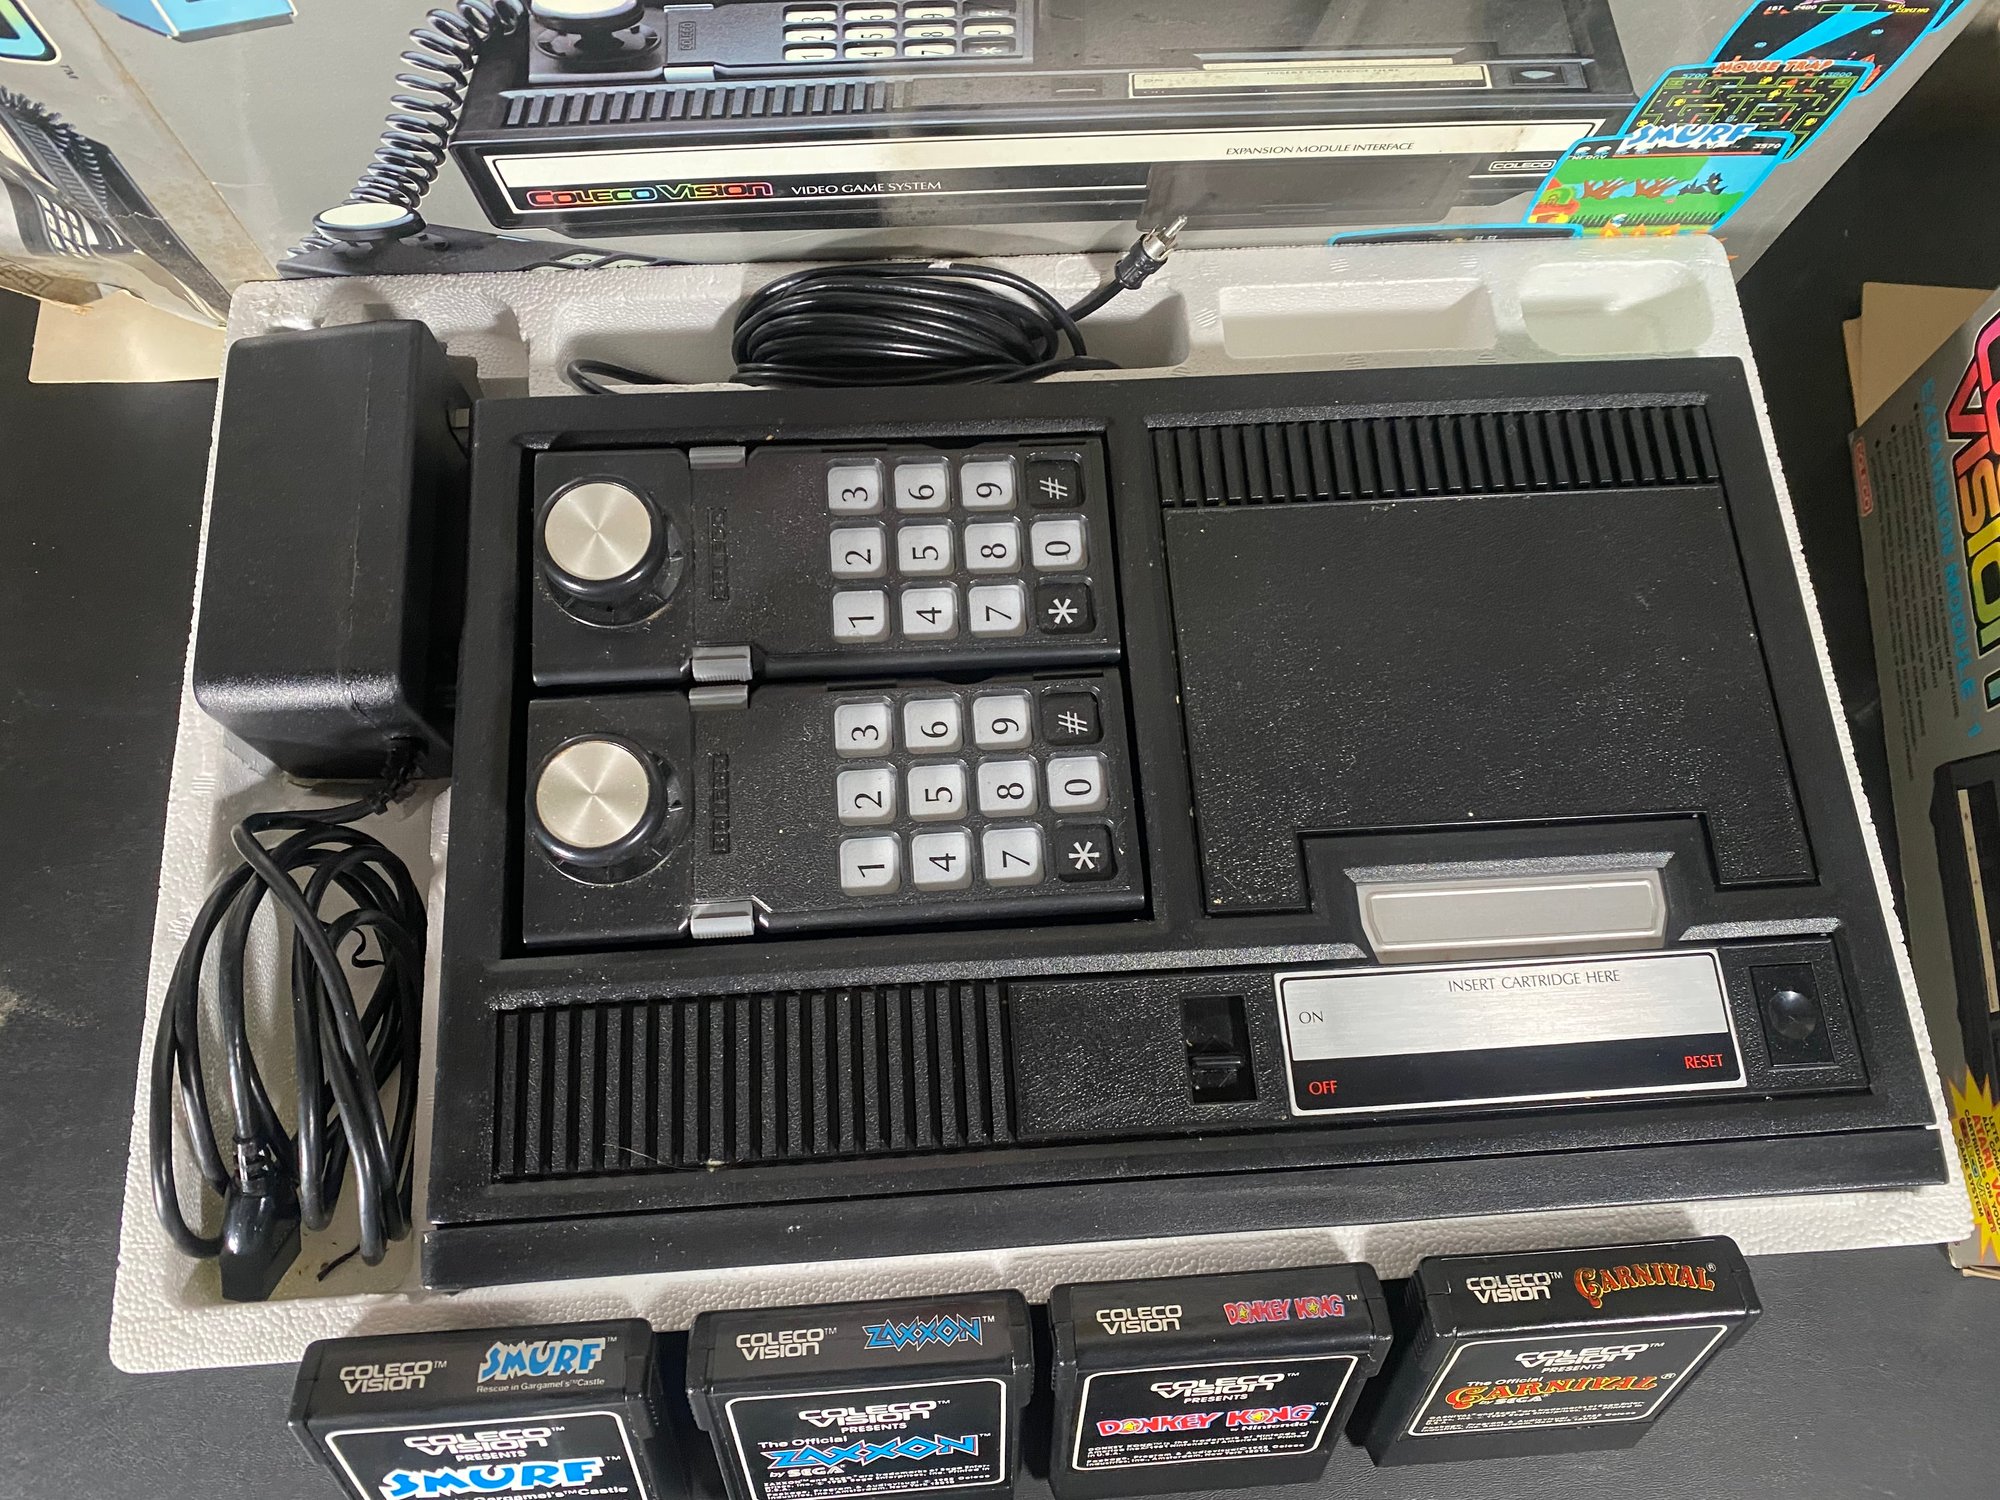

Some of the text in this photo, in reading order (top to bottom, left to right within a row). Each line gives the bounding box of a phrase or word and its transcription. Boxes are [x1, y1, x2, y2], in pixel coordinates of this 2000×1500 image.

[1712, 59, 1835, 74] MOUSE TRAP
[1617, 123, 1759, 150] SMURF
[1226, 141, 1415, 156] EXPANSION MODULE INTERFACE
[1491, 160, 1554, 171] COLECO
[791, 179, 942, 196] VIDEO GAME SYSTEM
[841, 484, 869, 503] 3
[908, 484, 936, 501] 6
[975, 481, 1003, 499] 9
[845, 548, 872, 566] 2
[913, 545, 940, 562] 5
[981, 543, 1008, 560] 8
[1045, 540, 1072, 557] 0
[848, 614, 875, 627] 1
[916, 606, 943, 625] 4
[984, 605, 1013, 623] 7
[1945, 561, 1980, 699] MODULE
[852, 723, 879, 742] 3
[921, 720, 949, 739] 6
[991, 717, 1019, 735] 9
[925, 787, 953, 804] 5
[996, 782, 1025, 801] 8
[1064, 779, 1092, 797] 0
[855, 790, 883, 810] 2
[929, 852, 957, 872] 4
[1002, 849, 1031, 869] 7
[858, 862, 886, 878] 1
[1447, 967, 1621, 994] INSERT CARTRIDGE HERE
[1298, 1008, 1325, 1025] ON
[1683, 1052, 1724, 1071] RESET
[1309, 1079, 1338, 1096] OFF
[1982, 1116, 1993, 1137] ALL
[1971, 1114, 1994, 1169] ATARI
[1964, 1109, 1987, 1179] CARTRIDGES
[1985, 1182, 1993, 1199] ON
[1958, 1138, 1984, 1218] GAME SYSTEM
[1474, 1285, 1552, 1305] VISION
[1095, 1304, 1183, 1323] COLECO
[1223, 1299, 1291, 1326] DONKEY
[1102, 1318, 1181, 1335] VISION
[741, 1341, 820, 1362] VISION
[1521, 1352, 1636, 1369] VISION
[1541, 1363, 1606, 1374] PRESENTS
[343, 1374, 428, 1395] VISION
[476, 1385, 509, 1393] Rescue
[577, 1378, 605, 1387] Castle
[1499, 1376, 1544, 1385] Official
[1157, 1382, 1275, 1399] VISION
[1183, 1393, 1248, 1404] PRESENTS
[807, 1410, 931, 1429] VISION
[841, 1421, 908, 1434] PRESENTS
[1096, 1411, 1225, 1437] DONKEY
[410, 1436, 550, 1457] VISION
[757, 1435, 848, 1449] The Official
[455, 1449, 528, 1462] PRESENTS
[577, 1486, 629, 1497] Castle
